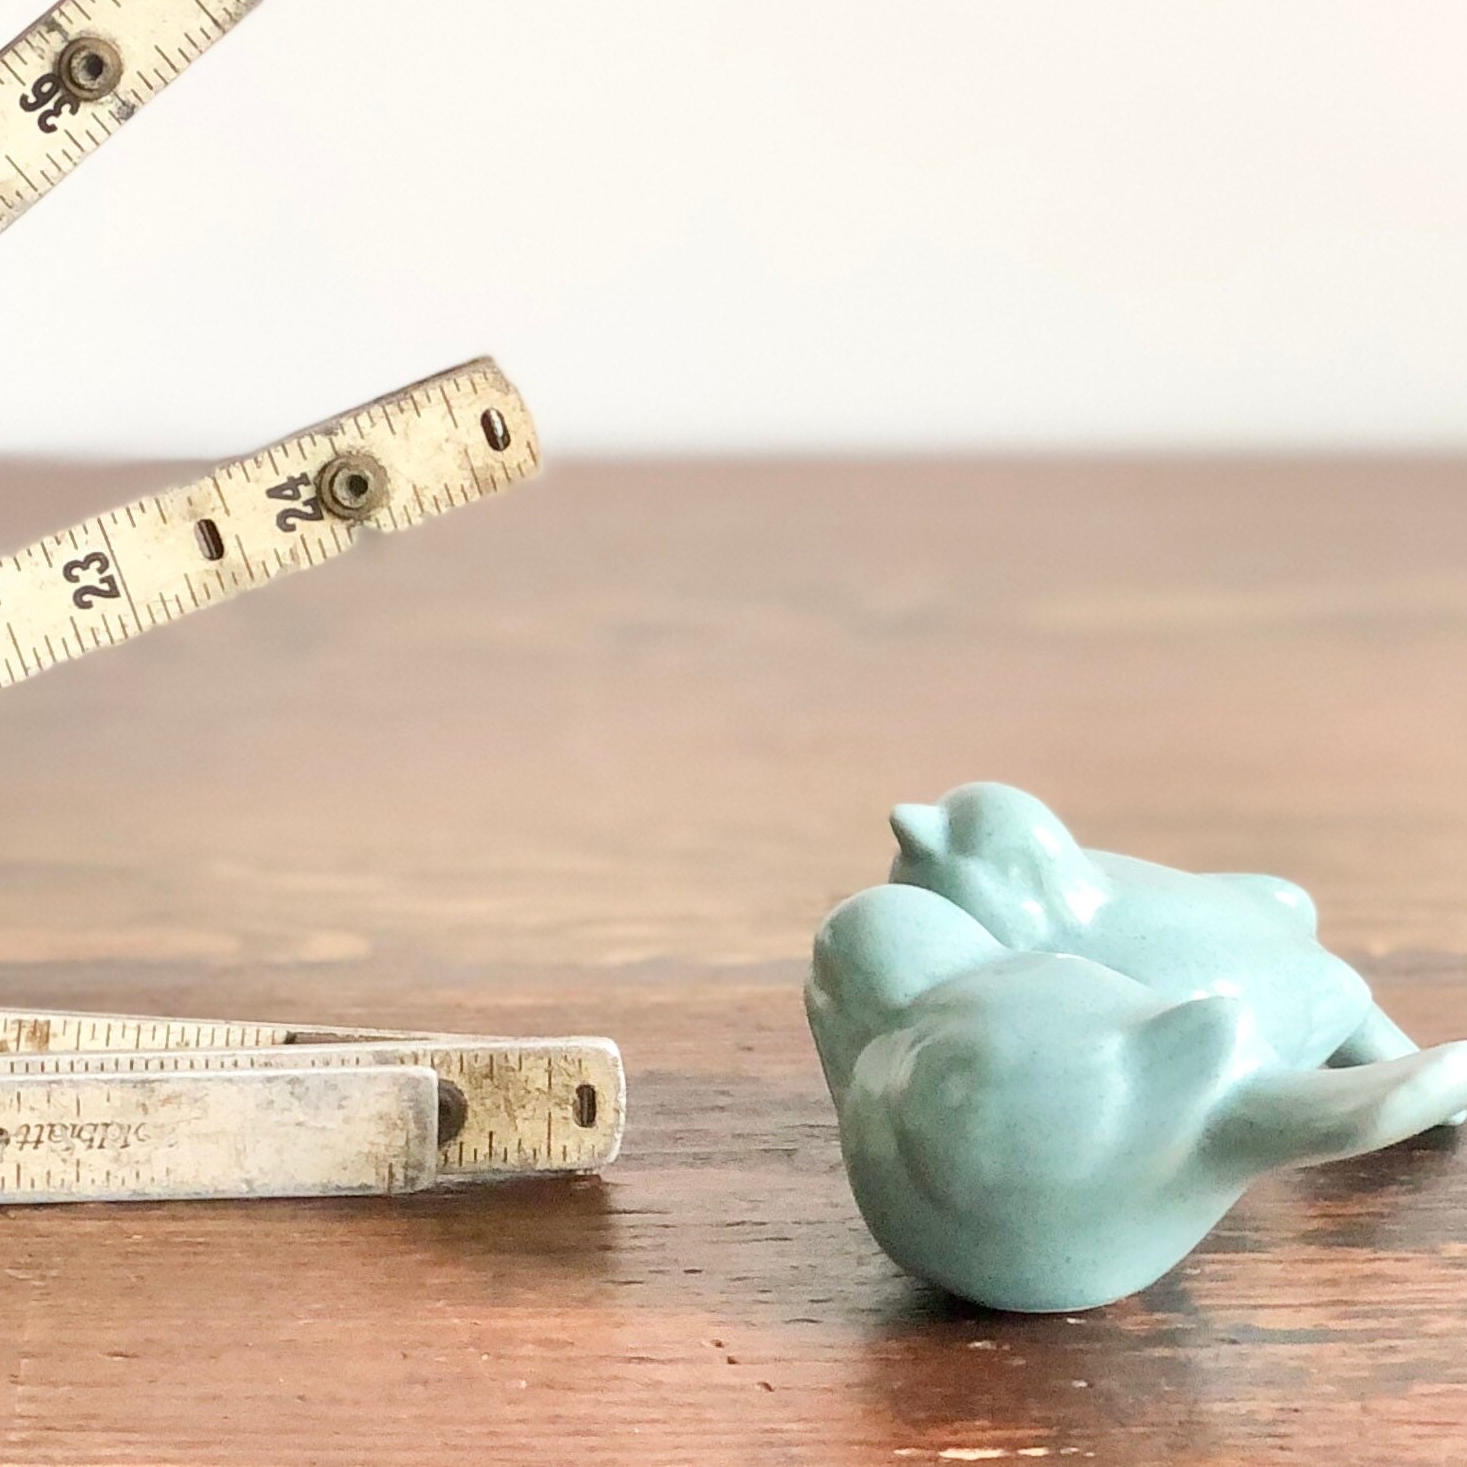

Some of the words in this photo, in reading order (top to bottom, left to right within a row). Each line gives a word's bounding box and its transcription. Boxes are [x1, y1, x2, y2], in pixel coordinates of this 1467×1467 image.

[19, 72, 80, 134] 36
[266, 471, 324, 534] 24
[63, 551, 121, 610] 23
